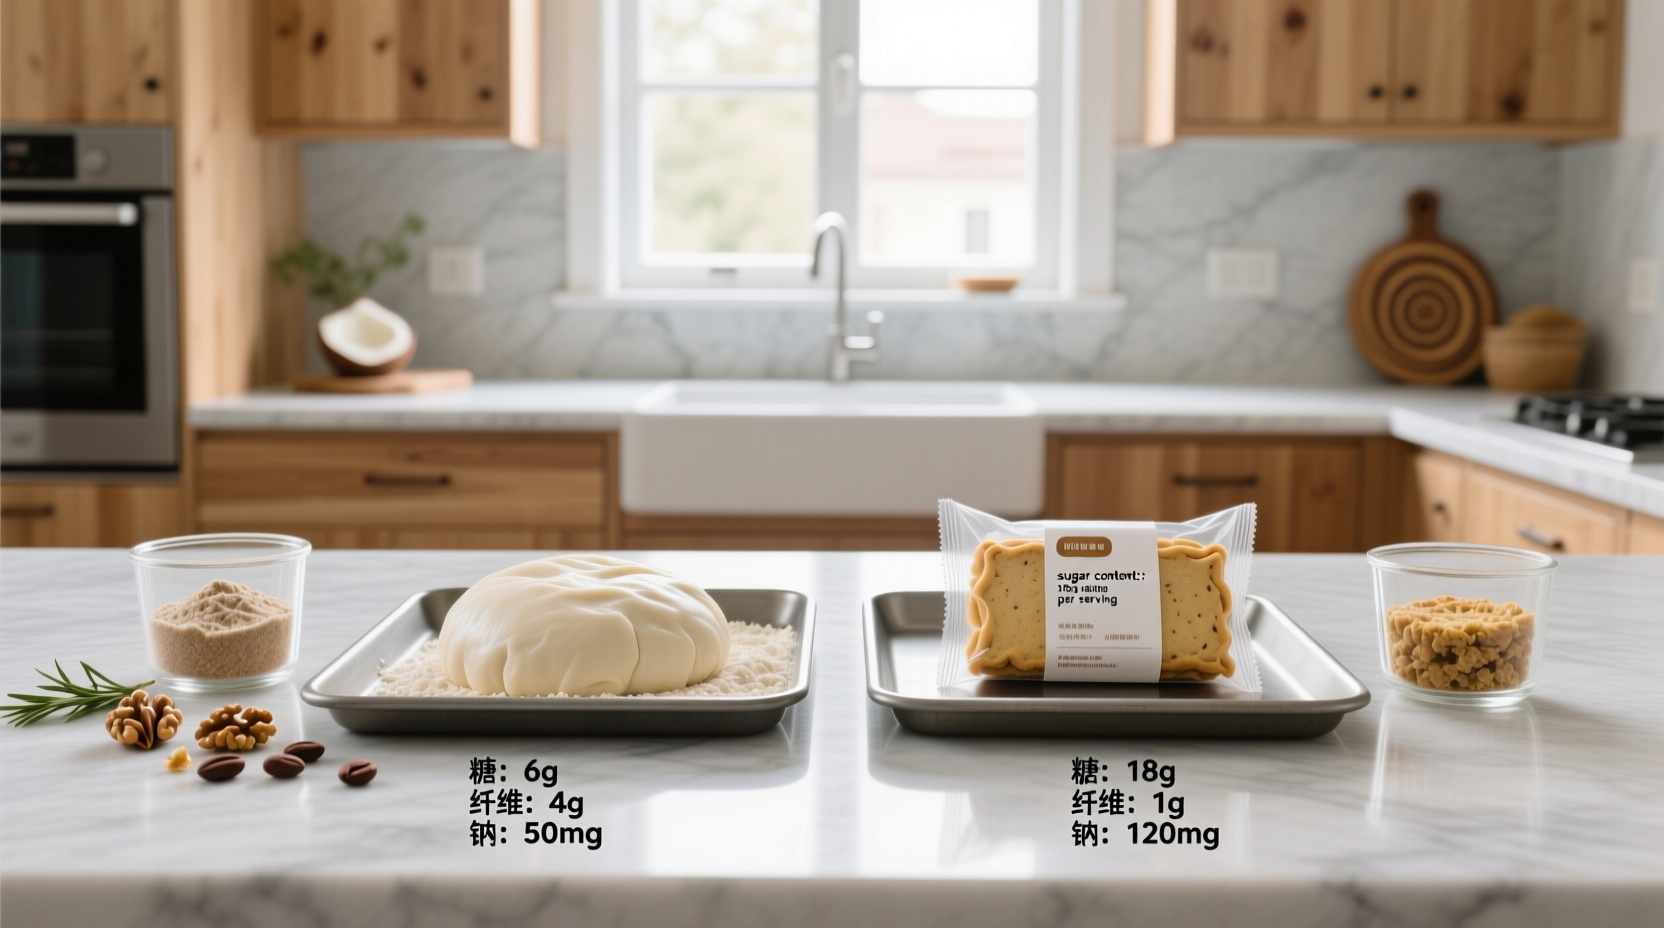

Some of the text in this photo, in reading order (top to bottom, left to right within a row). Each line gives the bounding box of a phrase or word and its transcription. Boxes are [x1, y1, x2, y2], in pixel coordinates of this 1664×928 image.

[1057, 572, 1090, 584] sugar
[1058, 594, 1118, 607] per serving
